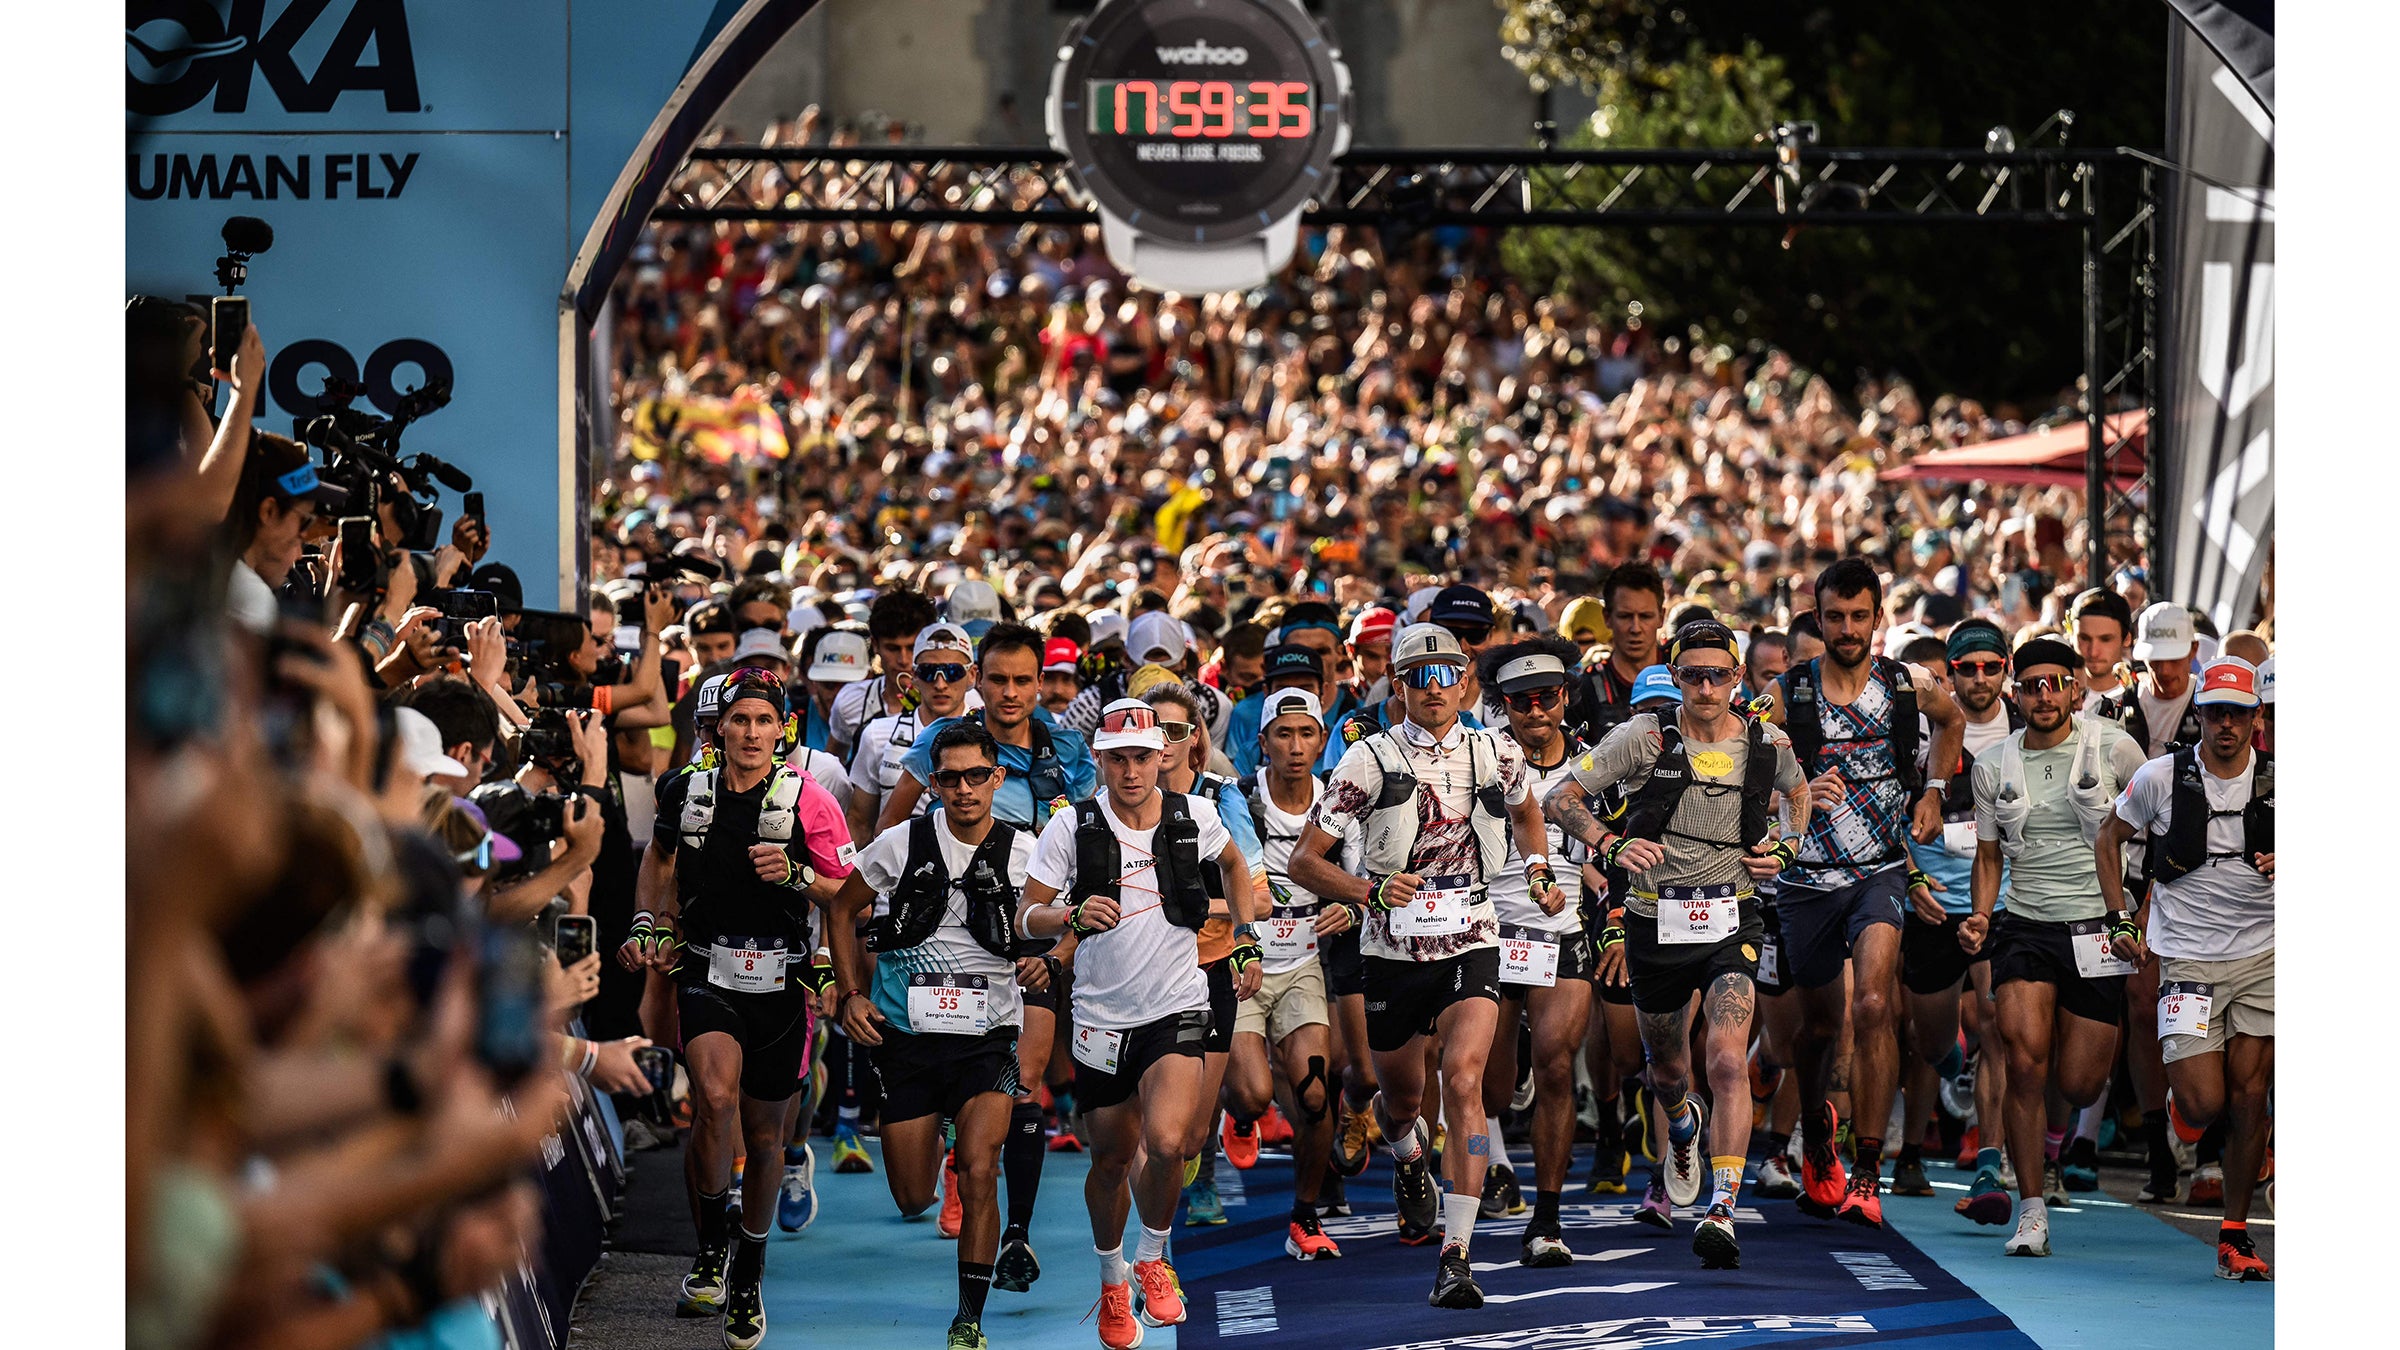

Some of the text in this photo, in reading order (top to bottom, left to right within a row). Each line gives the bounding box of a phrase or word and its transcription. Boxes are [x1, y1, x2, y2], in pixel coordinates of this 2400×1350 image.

[126, 0, 422, 116] OKA
[1156, 39, 1248, 65] wahoo
[1114, 81, 1311, 138] 17:59:35
[127, 153, 421, 200] UMAN FLY
[2146, 628, 2177, 639] HOKA
[821, 652, 855, 664] HOKA
[1276, 652, 1310, 666] HOKA
[1133, 859, 1155, 868] TERR
[1414, 891, 1444, 900] UTMB
[1425, 901, 1436, 913] 9
[1683, 901, 1710, 909] UTMB
[1415, 915, 1448, 924] Mathieu
[1688, 909, 1709, 921] 66
[998, 903, 1011, 944] SCARPA
[1272, 919, 1297, 927] UTMB
[1689, 923, 1709, 931] Scott
[1276, 927, 1295, 939] 37
[1505, 940, 1532, 949] UTMB
[2101, 943, 2110, 954] 6
[734, 950, 763, 959] UTMB
[1509, 949, 1528, 962] 82
[744, 960, 754, 972] 8
[1505, 963, 1529, 972] Sangé
[734, 972, 763, 981] Hannes
[933, 988, 961, 997] UTMB
[938, 997, 959, 1011] 55
[2163, 994, 2185, 1005] UTMB
[2167, 1003, 2181, 1015] 16
[925, 1011, 970, 1020] Sergio Gustavo
[1080, 1029, 1088, 1042] 4
[1075, 1039, 1092, 1054] Petter
